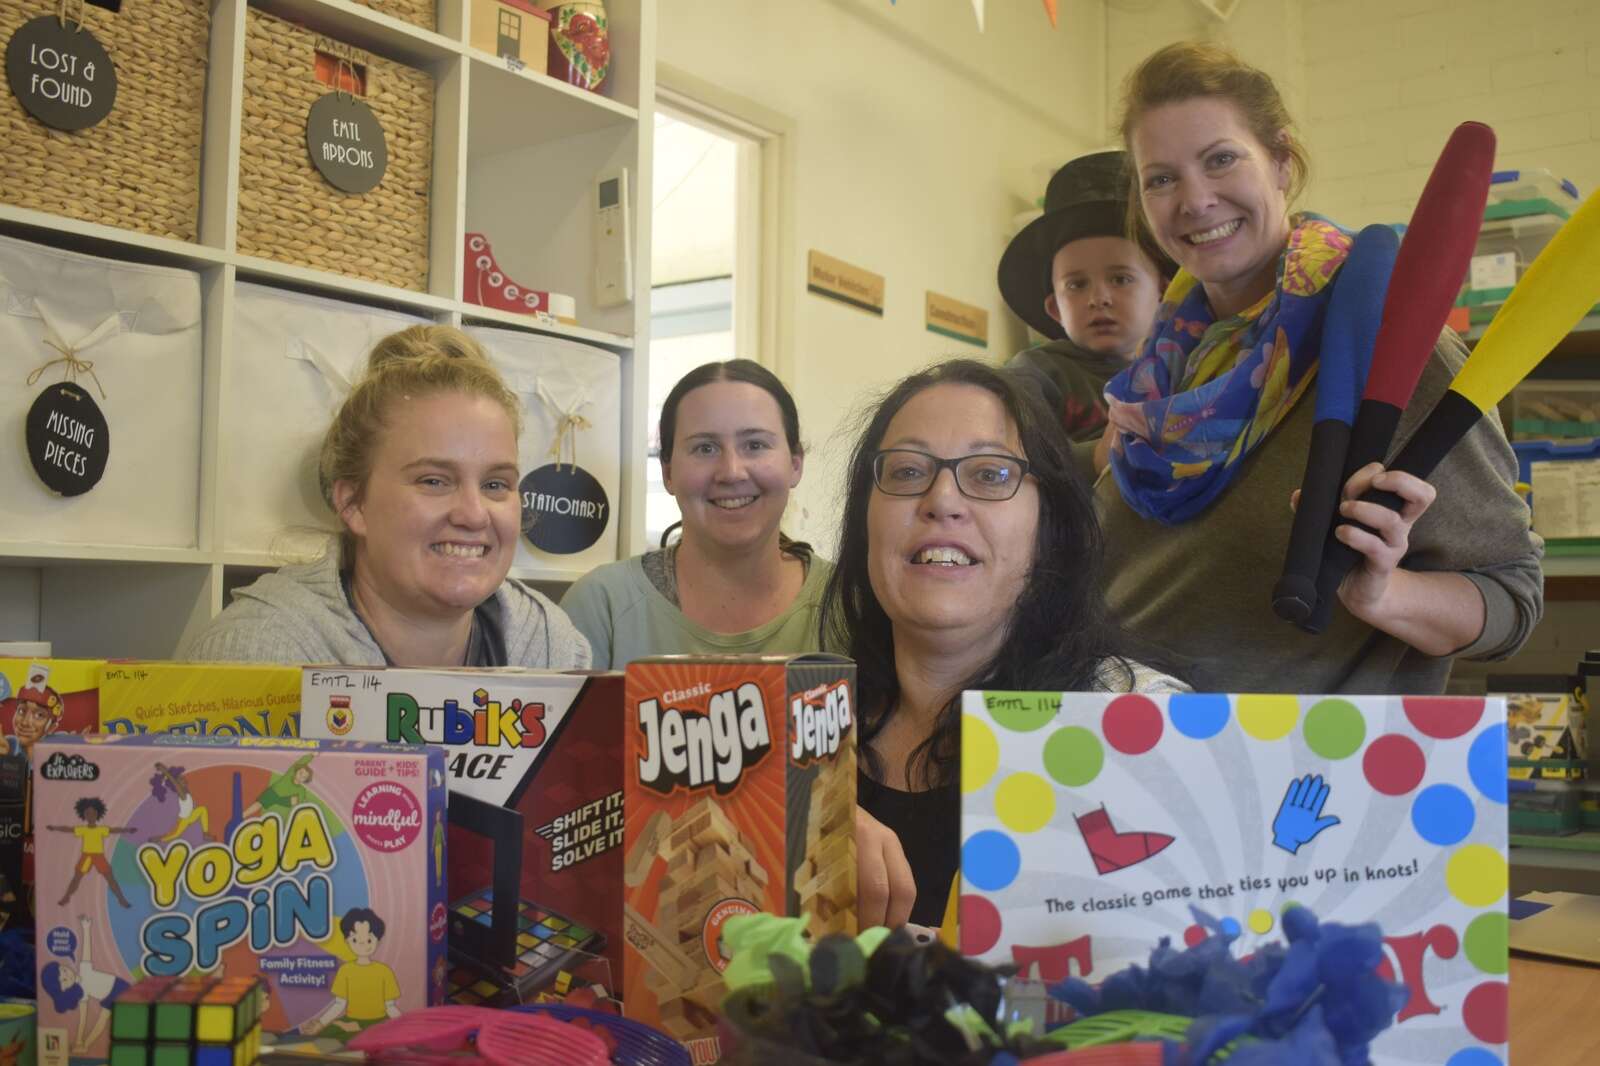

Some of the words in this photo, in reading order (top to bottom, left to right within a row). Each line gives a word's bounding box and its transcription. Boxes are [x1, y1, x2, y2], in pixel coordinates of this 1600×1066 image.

[31, 43, 77, 76] LOST
[83, 61, 95, 81] &
[31, 73, 92, 108] FOUND
[333, 119, 360, 141] EMTL
[323, 142, 373, 168] APRONS
[46, 409, 94, 449] MISSING
[44, 440, 87, 476] PIECES
[523, 491, 605, 520] STATIONARY
[361, 674, 382, 691] 114
[663, 681, 712, 704] Classic
[135, 704, 164, 720] Quick
[168, 700, 220, 717] Sketches,
[386, 687, 546, 749] Rubik's
[1037, 698, 1063, 713] 114
[639, 683, 770, 787] Jenga
[792, 684, 851, 759] Jenga
[354, 768, 386, 777] GUIDE
[358, 784, 402, 808] LEARNING
[353, 808, 420, 832] mindful
[552, 799, 604, 833] SHIFT
[552, 818, 602, 852] SLIDE
[552, 836, 606, 871] SOLVE
[1045, 898, 1075, 913] The
[1082, 893, 1137, 913] classic
[1142, 885, 1192, 906] game
[1198, 884, 1234, 899] that
[1239, 875, 1272, 892] ties
[1277, 874, 1309, 893] you
[1314, 867, 1337, 884] up
[1343, 868, 1360, 882] in
[1365, 858, 1419, 880] knots!
[260, 957, 296, 971] Family
[297, 957, 335, 968] Fitness
[280, 973, 326, 987] Activity!
